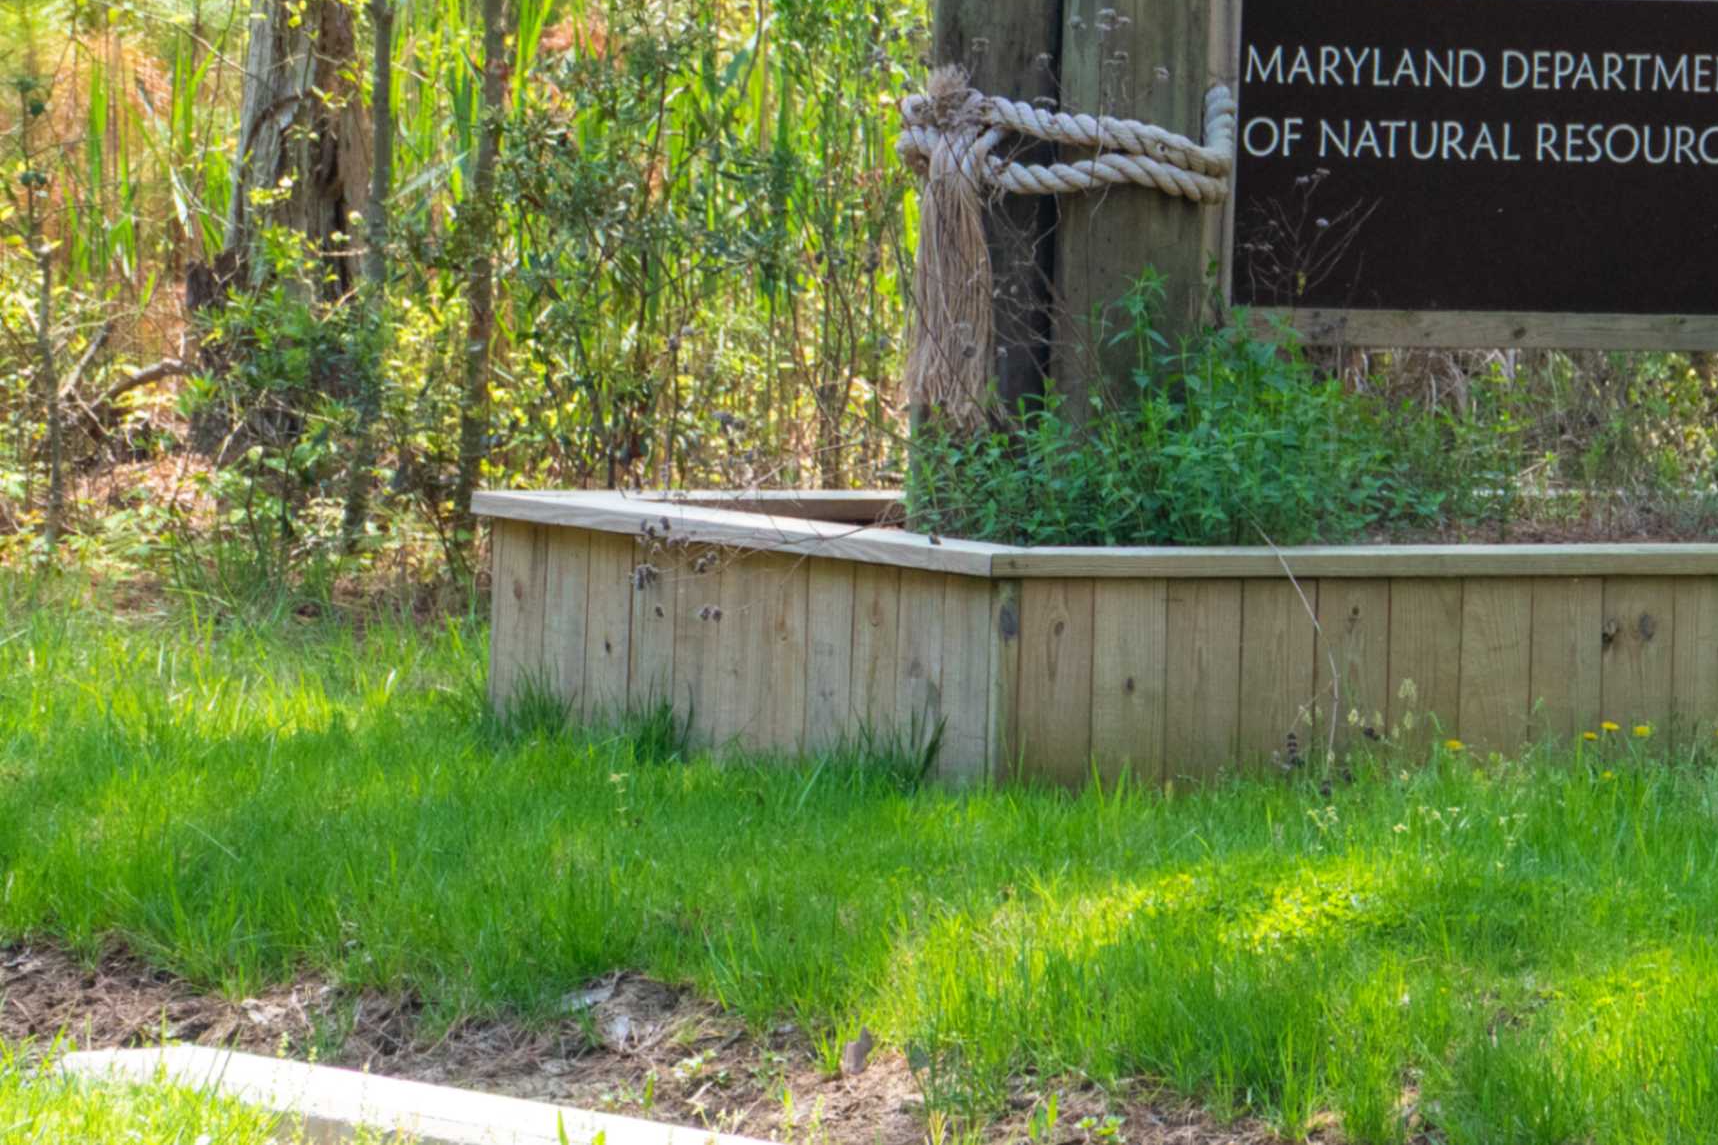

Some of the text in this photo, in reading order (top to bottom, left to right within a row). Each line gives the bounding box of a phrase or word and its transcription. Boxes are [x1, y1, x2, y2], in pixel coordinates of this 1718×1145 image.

[1245, 44, 1486, 88] MARYLAND
[1243, 117, 1303, 156] OF
[1319, 120, 1521, 161] NATURAL
